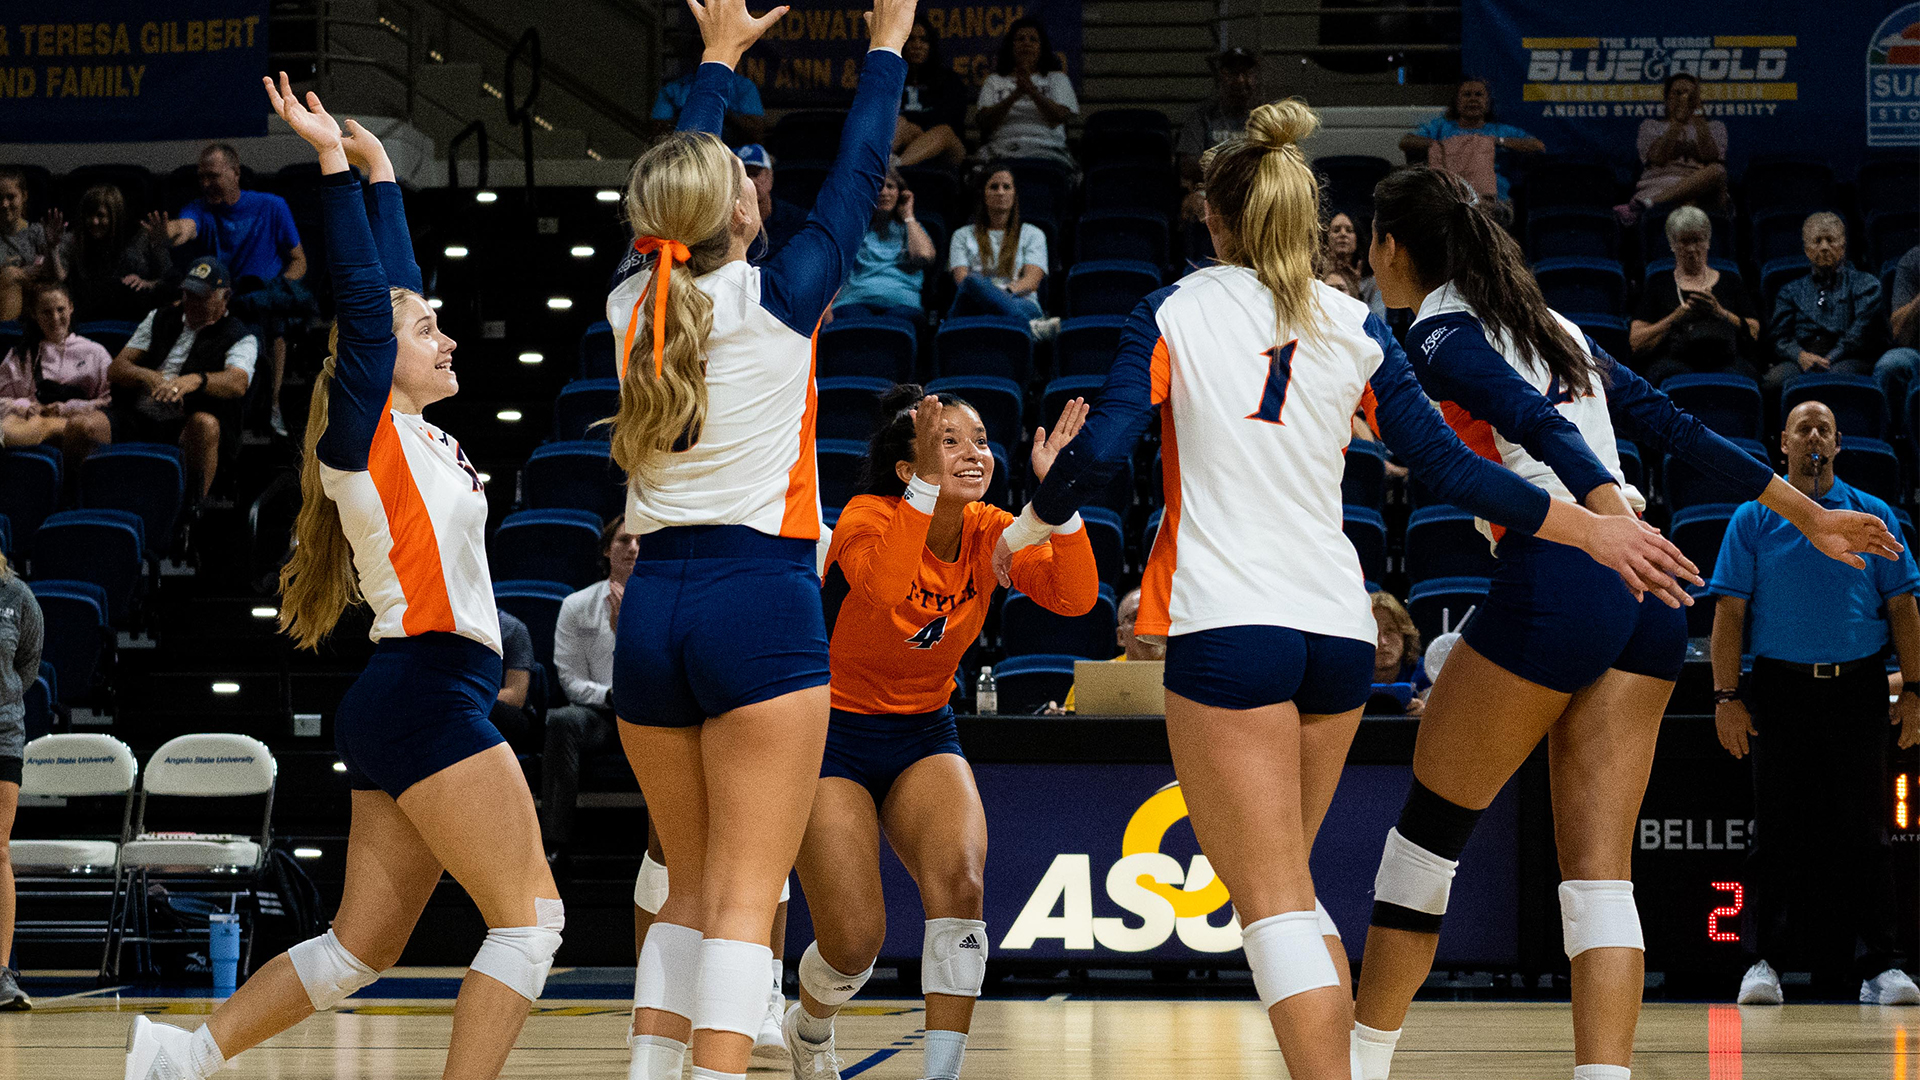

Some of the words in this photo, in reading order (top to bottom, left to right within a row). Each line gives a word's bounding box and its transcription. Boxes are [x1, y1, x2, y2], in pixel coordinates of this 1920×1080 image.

[20, 23, 131, 55] TERESA
[140, 16, 260, 53] GILBERT
[1602, 37, 1626, 48] THE
[46, 65, 146, 98] FAMILY
[1542, 104, 1608, 117] ANGELO
[1614, 104, 1665, 117] STATE
[1703, 103, 1777, 116] VERSITY
[1243, 338, 1299, 427] 1
[904, 615, 948, 650] 4
[27, 757, 55, 765] Angelo
[77, 756, 116, 764] University
[164, 756, 193, 765] Angelo
[194, 756, 215, 764] State
[216, 756, 255, 764] University
[1708, 882, 1743, 941] 2
